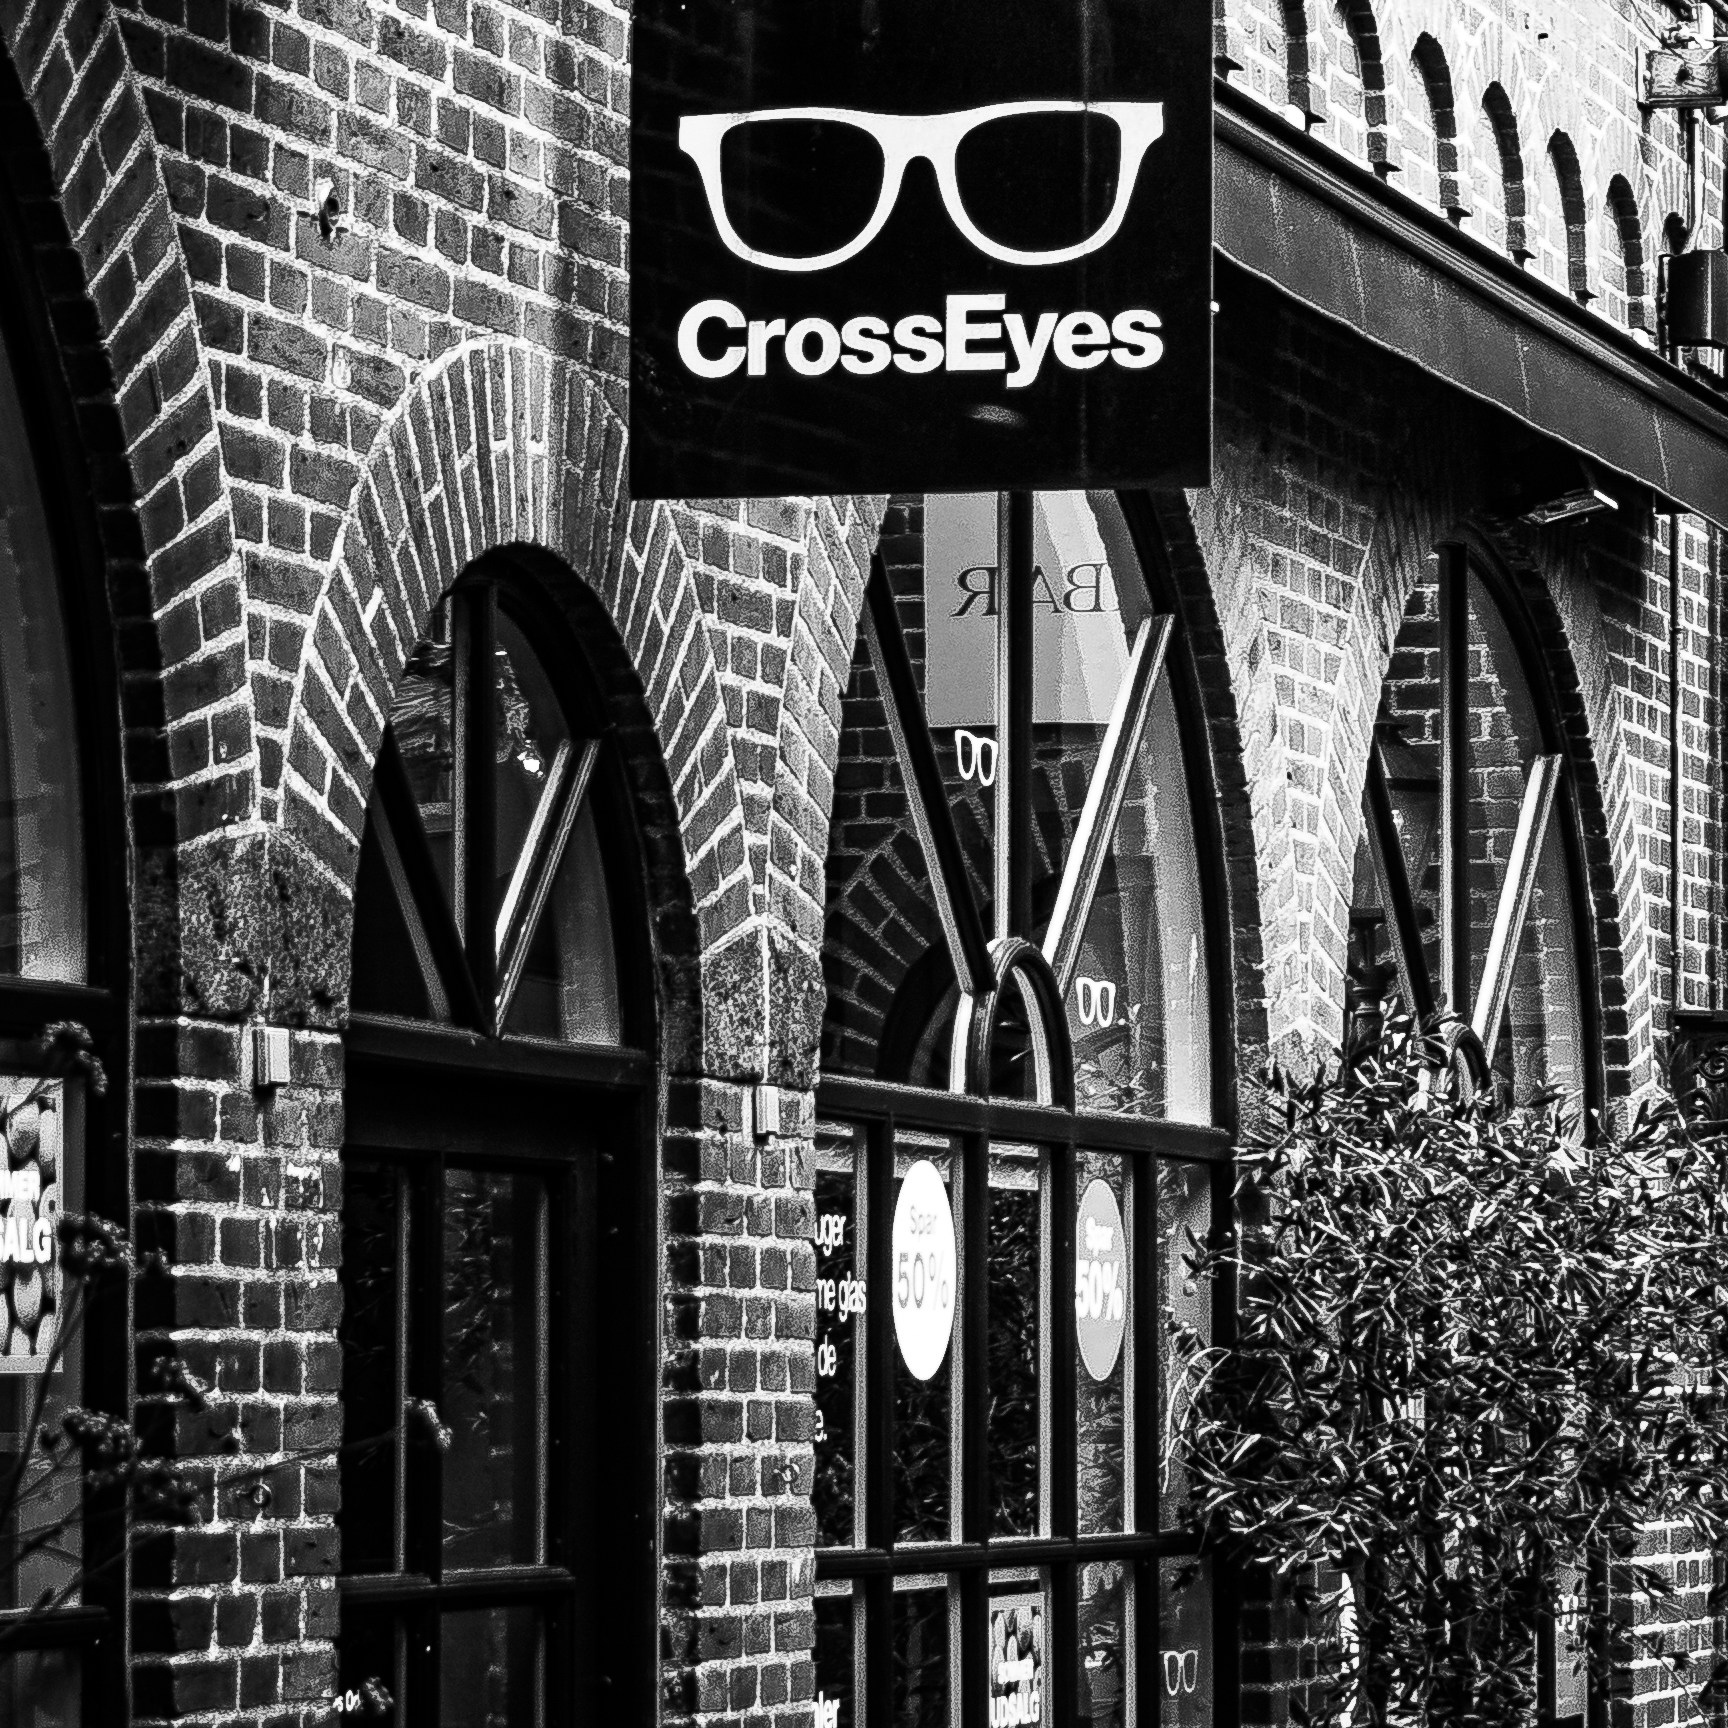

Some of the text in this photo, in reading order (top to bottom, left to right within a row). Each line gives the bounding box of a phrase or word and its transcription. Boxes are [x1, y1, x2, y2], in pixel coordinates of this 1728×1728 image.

[677, 293, 1164, 388] CrossEyes
[897, 1250, 949, 1311] 50%
[1075, 1259, 1124, 1320] 50%
[988, 1690, 1040, 1728] UDSALG
